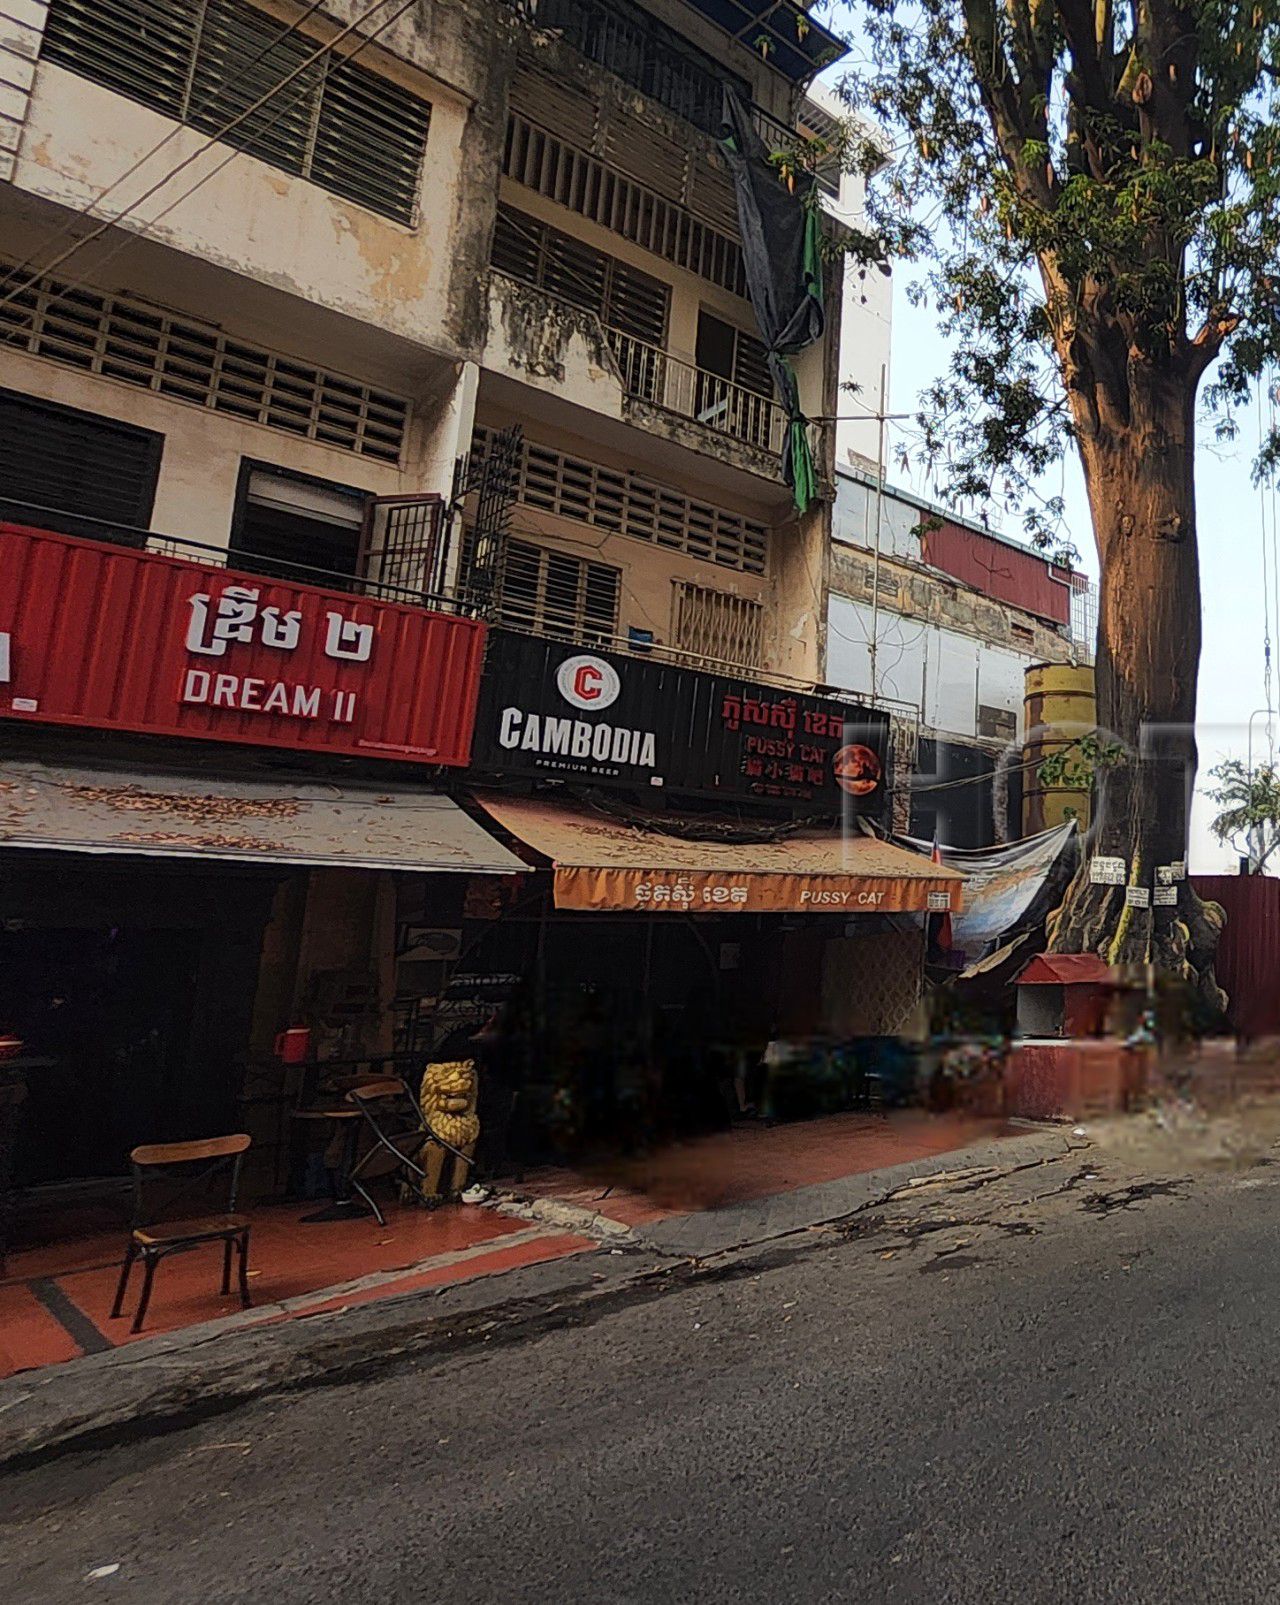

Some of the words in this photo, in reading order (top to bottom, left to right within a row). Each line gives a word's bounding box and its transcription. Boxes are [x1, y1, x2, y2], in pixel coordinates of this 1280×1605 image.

[186, 586, 302, 656] ឌ្រីម
[325, 611, 374, 662] ២
[184, 669, 321, 718] DREAM
[333, 691, 356, 722] II
[499, 706, 656, 768] CAMBODIA
[746, 736, 795, 759] PUSSY
[800, 745, 827, 764] CAT
[536, 759, 588, 773] PREMIUM
[591, 767, 619, 776] BEER
[800, 891, 850, 904] PUSSY
[858, 892, 885, 904] CAT
